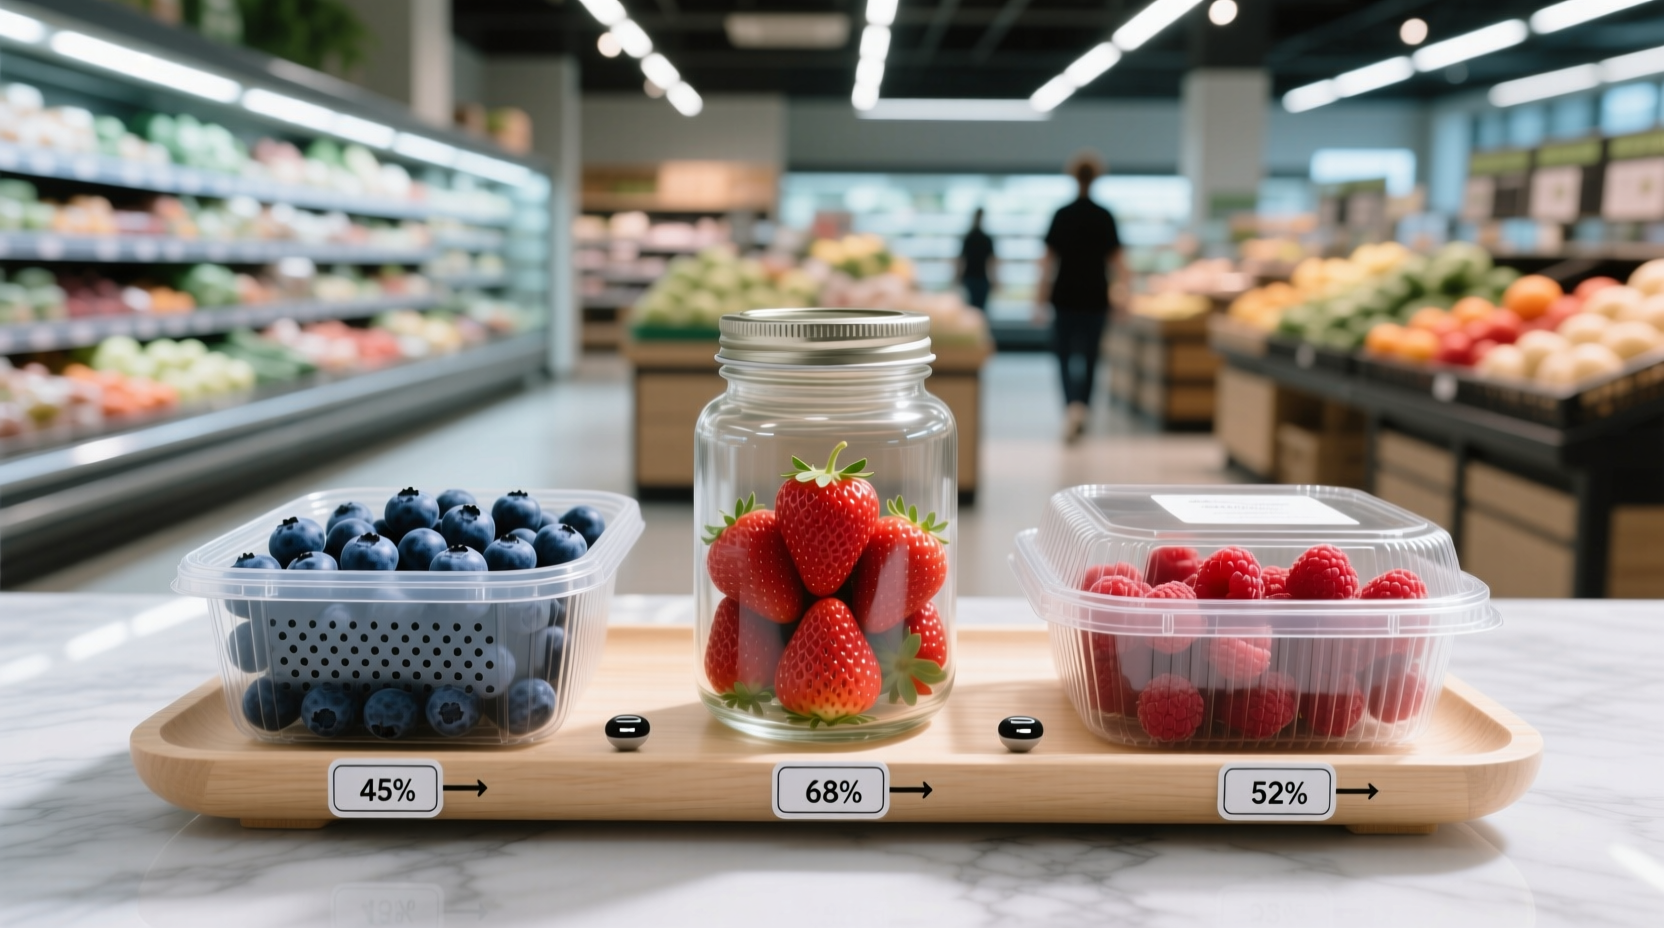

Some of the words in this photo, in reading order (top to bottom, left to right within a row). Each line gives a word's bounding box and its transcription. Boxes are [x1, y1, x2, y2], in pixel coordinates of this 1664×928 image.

[359, 778, 416, 802] 45%
[805, 779, 863, 804] 68%
[1251, 780, 1308, 805] 52%
